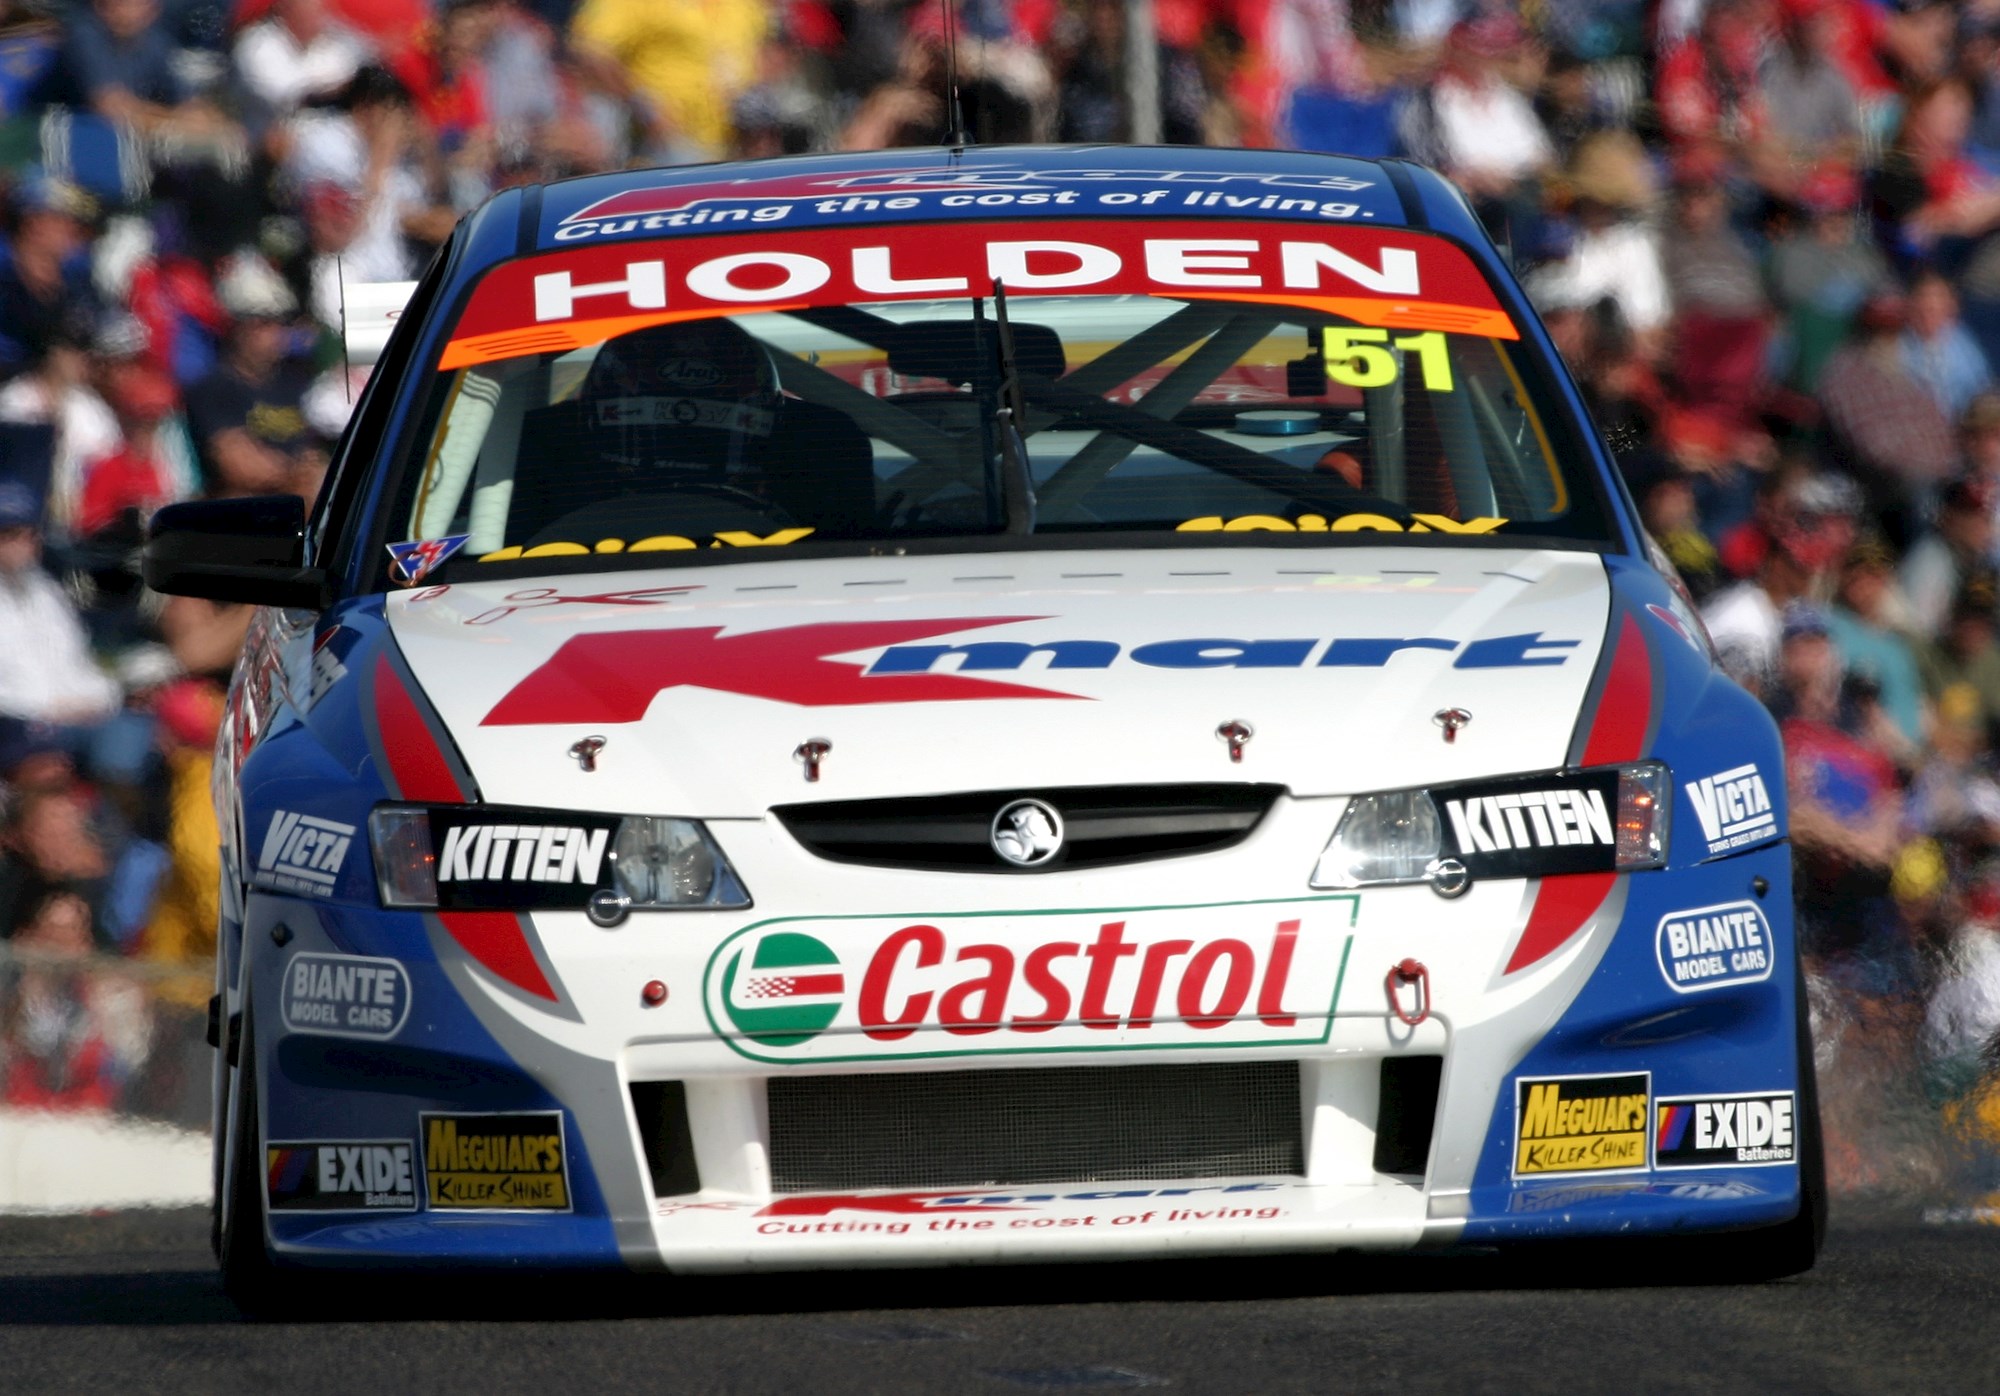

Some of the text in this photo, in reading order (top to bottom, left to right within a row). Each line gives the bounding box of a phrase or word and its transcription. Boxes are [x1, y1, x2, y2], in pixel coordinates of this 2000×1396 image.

[554, 190, 1375, 241] Cutting the cost of living.
[534, 238, 1420, 322] HOLDEN
[1322, 326, 1453, 392] 51
[478, 615, 1582, 727] Kmart
[1446, 789, 1614, 854] KITTEN
[1685, 774, 1771, 842] VICTA
[258, 809, 351, 873] VICTA
[438, 825, 609, 885] KITTEN
[1667, 912, 1763, 959] BIANTE
[293, 963, 397, 1005] BIANTE
[858, 919, 1301, 1042] Castrol
[1674, 949, 1767, 981] MODEL CARS
[290, 1004, 393, 1028] MODEL CARS
[1521, 1084, 1648, 1139] MEGUIAR'S
[1695, 1100, 1792, 1149] EXIDE
[317, 1145, 414, 1193] EXIDE
[427, 1119, 562, 1172] MEGUIAR'S
[1737, 1146, 1792, 1163] Batteries
[752, 1182, 1284, 1217] Kmart
[756, 1221, 911, 1235] Cutting
[927, 1217, 994, 1231] the
[1009, 1214, 1097, 1228] cost
[1110, 1211, 1159, 1225] of
